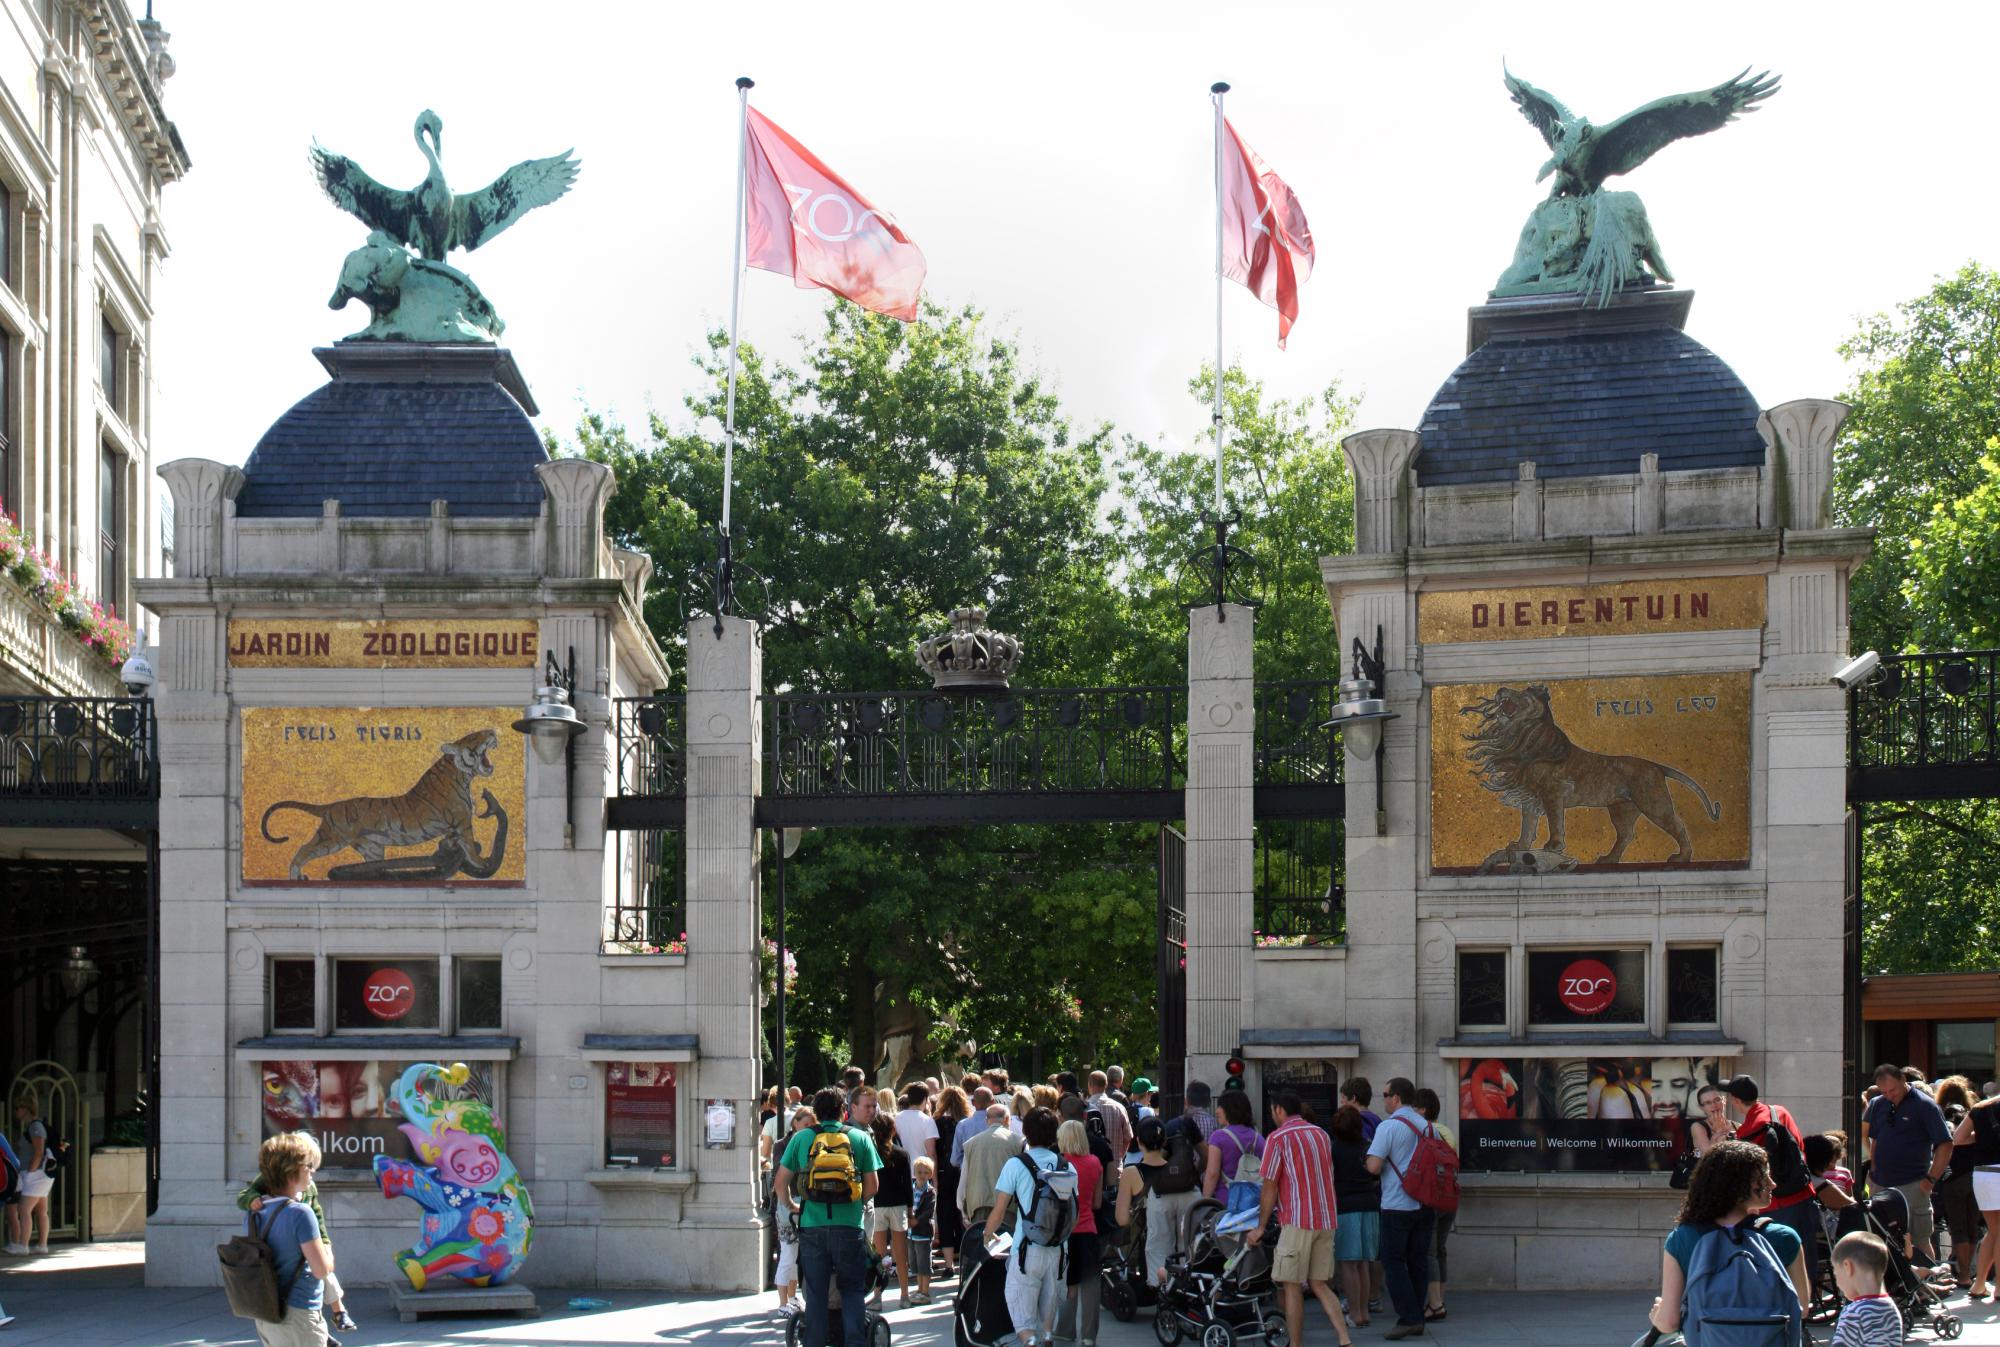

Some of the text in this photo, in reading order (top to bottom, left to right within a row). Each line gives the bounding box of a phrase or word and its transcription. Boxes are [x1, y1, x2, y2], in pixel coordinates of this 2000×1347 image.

[1472, 592, 1709, 628] DIERENTUIN
[230, 632, 537, 657] JARDIN ZOOLOGIQUE
[1596, 700, 1654, 717] FELIS
[284, 726, 422, 741] FELIS TIGRIS
[1479, 1137, 1673, 1149] Bienvenue Welcome Wilkommen
